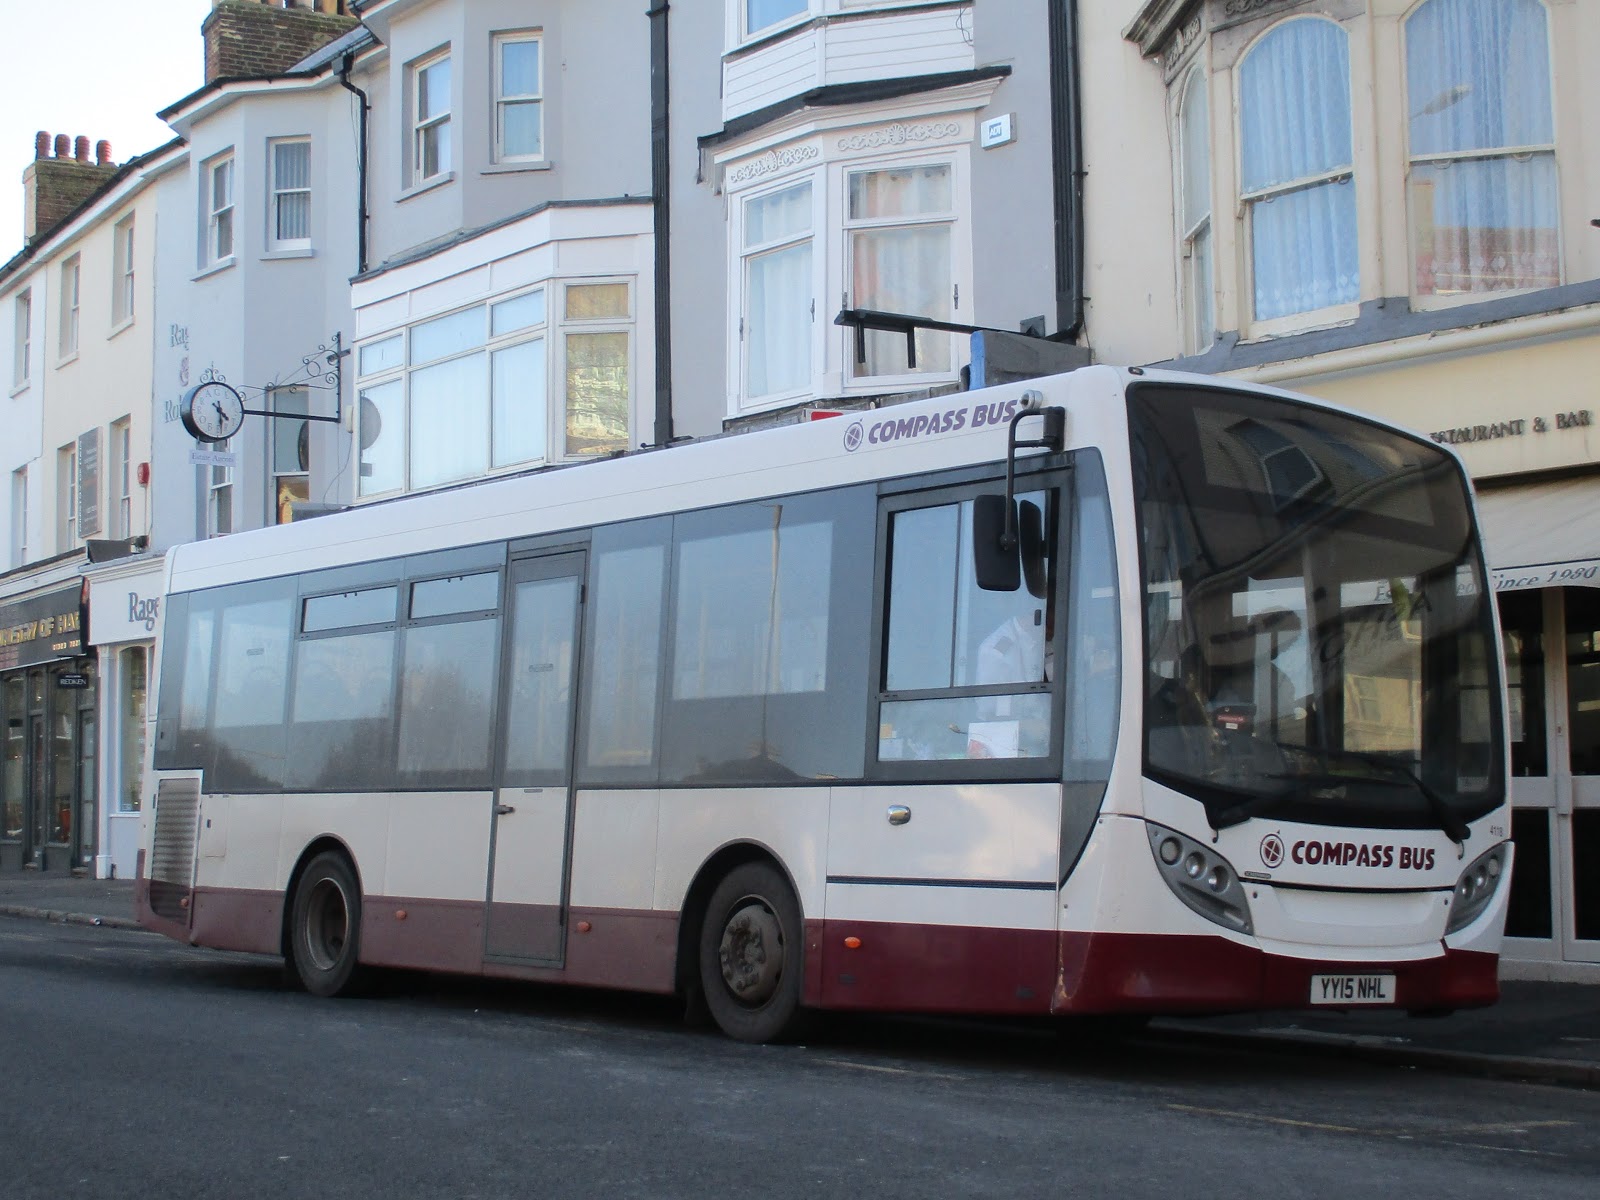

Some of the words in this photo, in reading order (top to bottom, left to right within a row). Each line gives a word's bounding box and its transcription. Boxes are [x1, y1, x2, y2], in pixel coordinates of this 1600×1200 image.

[868, 407, 968, 445] COMPASS
[970, 399, 1018, 428] BUS
[1533, 416, 1547, 433] &
[1555, 409, 1592, 430] BAR
[1493, 573, 1539, 590] ince
[40, 616, 55, 637] OF
[1291, 840, 1394, 868] COMPASS
[1399, 846, 1436, 870] BUS
[1321, 977, 1354, 998] YY15
[1357, 977, 1386, 998] NHL
